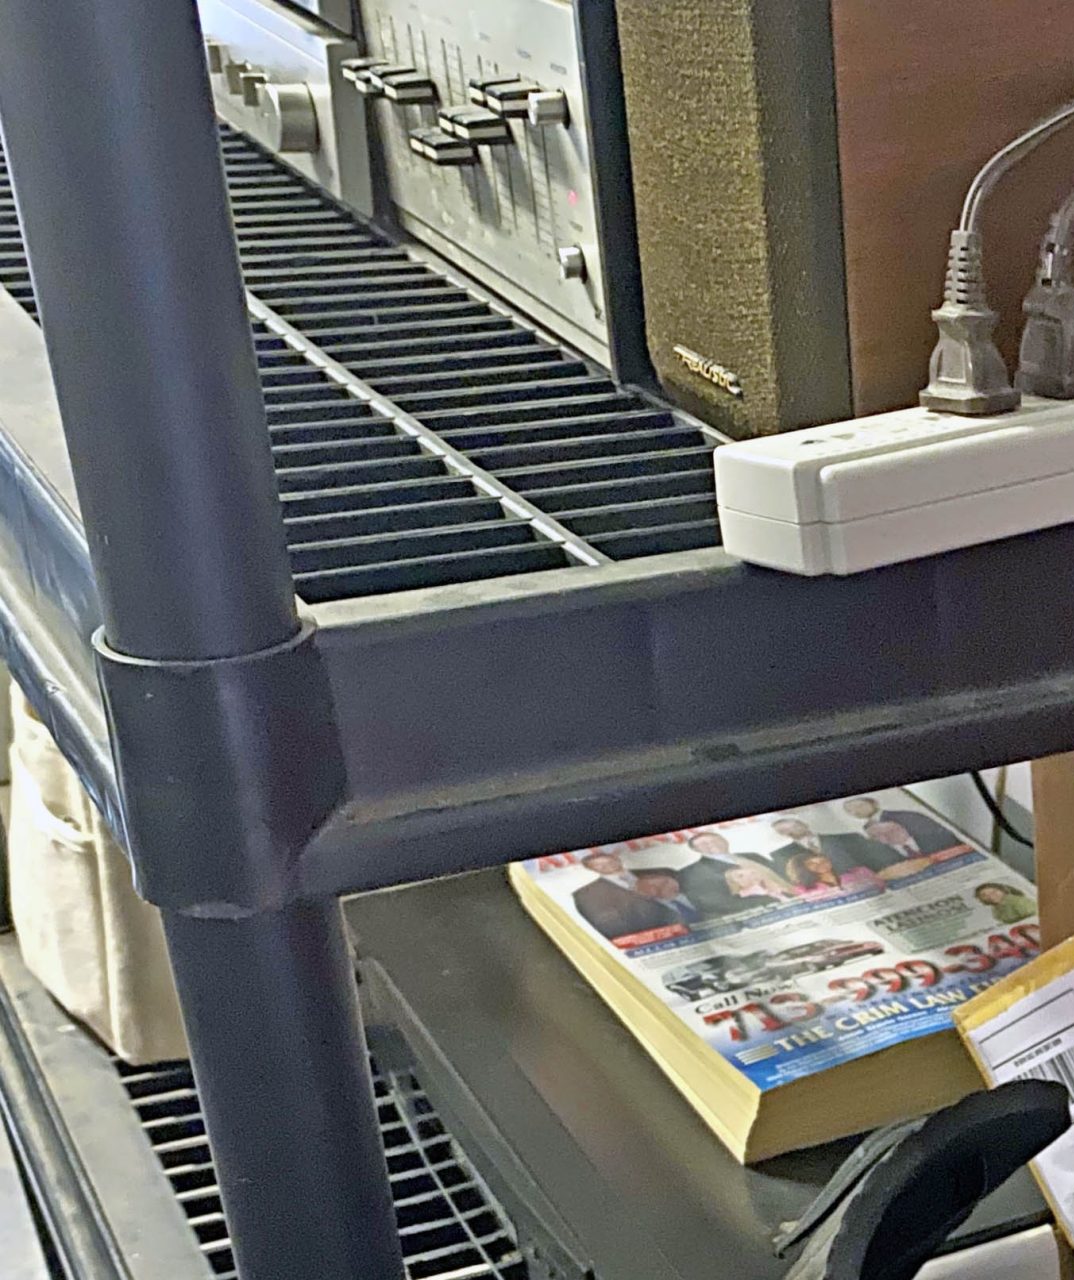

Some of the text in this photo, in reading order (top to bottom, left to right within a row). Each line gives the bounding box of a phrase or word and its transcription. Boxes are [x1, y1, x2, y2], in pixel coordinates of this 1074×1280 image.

[695, 992, 739, 1015] Call
[774, 1023, 832, 1051] THE
[835, 998, 908, 1031] CRIM
[908, 987, 967, 1014] LAW
